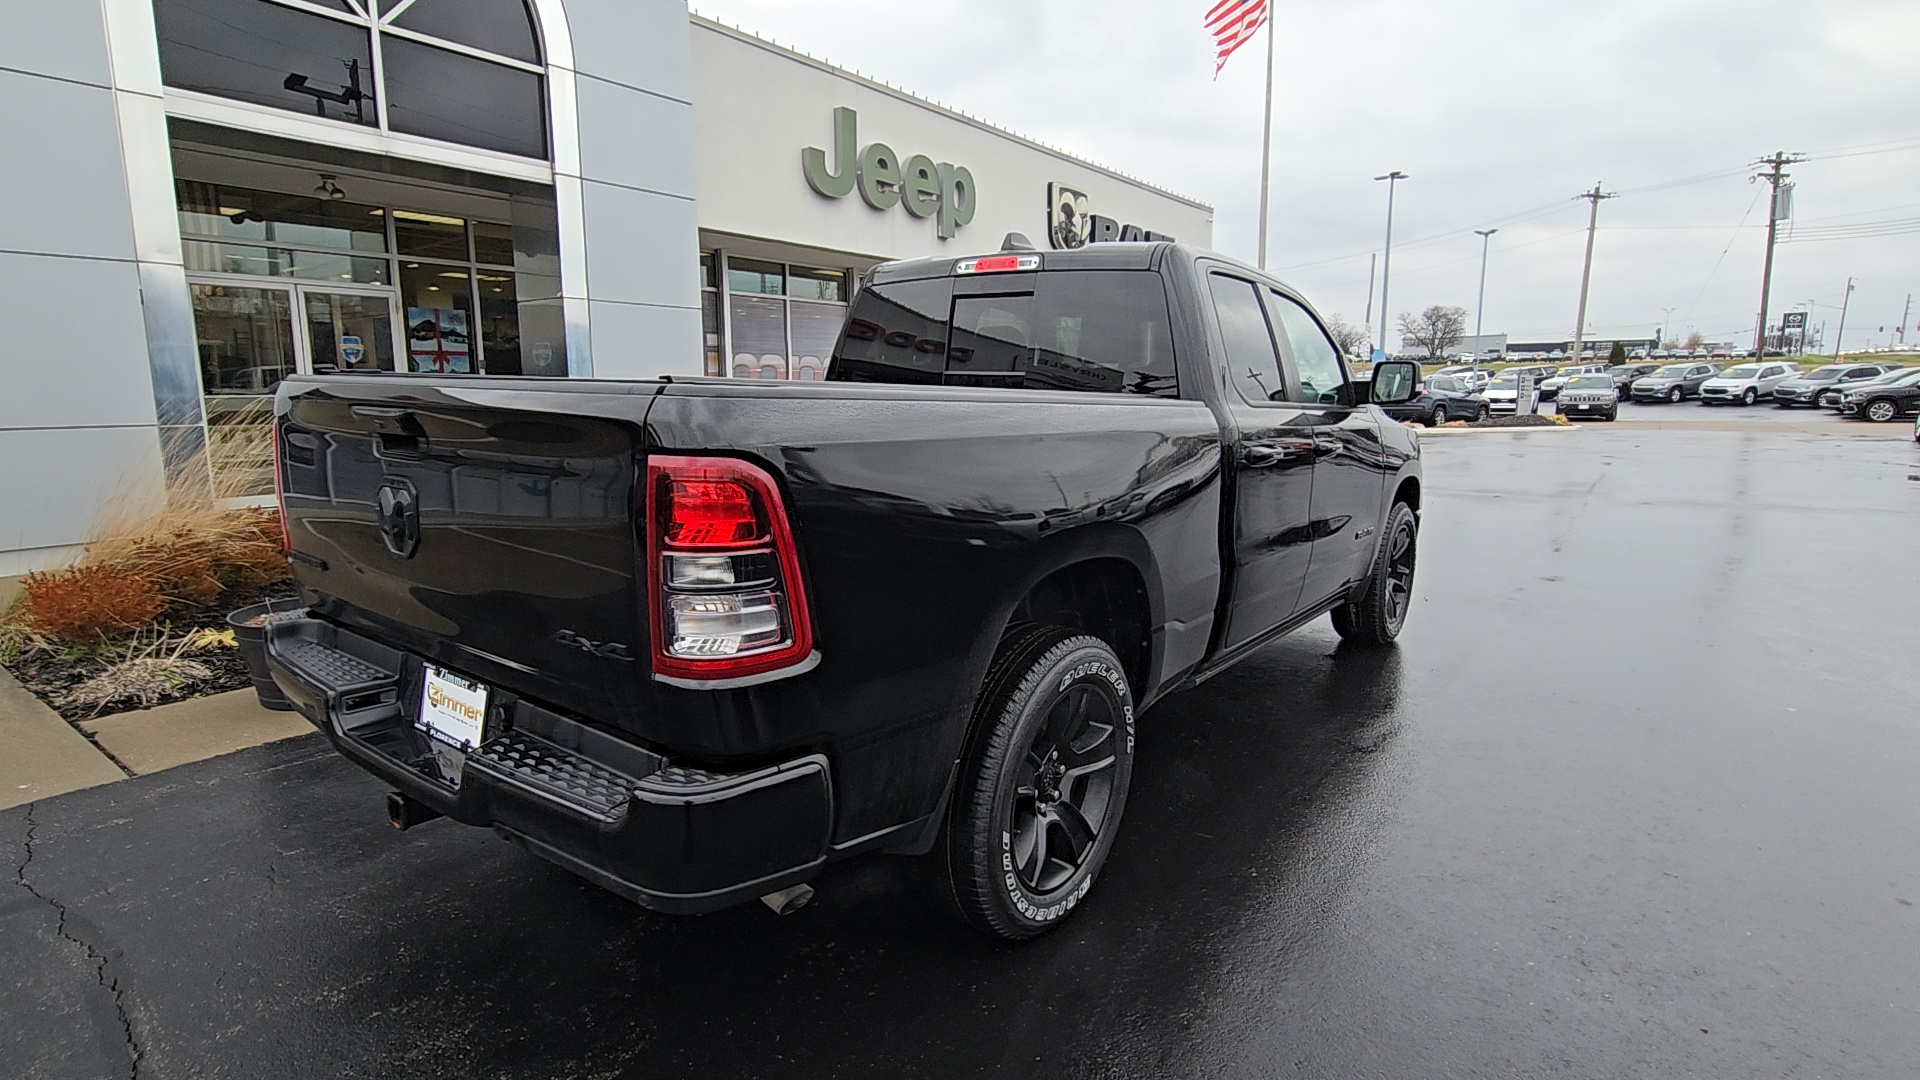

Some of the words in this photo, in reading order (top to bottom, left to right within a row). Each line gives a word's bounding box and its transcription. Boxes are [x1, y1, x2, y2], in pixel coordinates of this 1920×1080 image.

[801, 105, 977, 239] Jeep
[439, 667, 470, 690] Zimmer
[1059, 662, 1126, 696] DUELER
[429, 684, 482, 721] Zimmer
[1003, 831, 1092, 921] BRIDGESTONE
